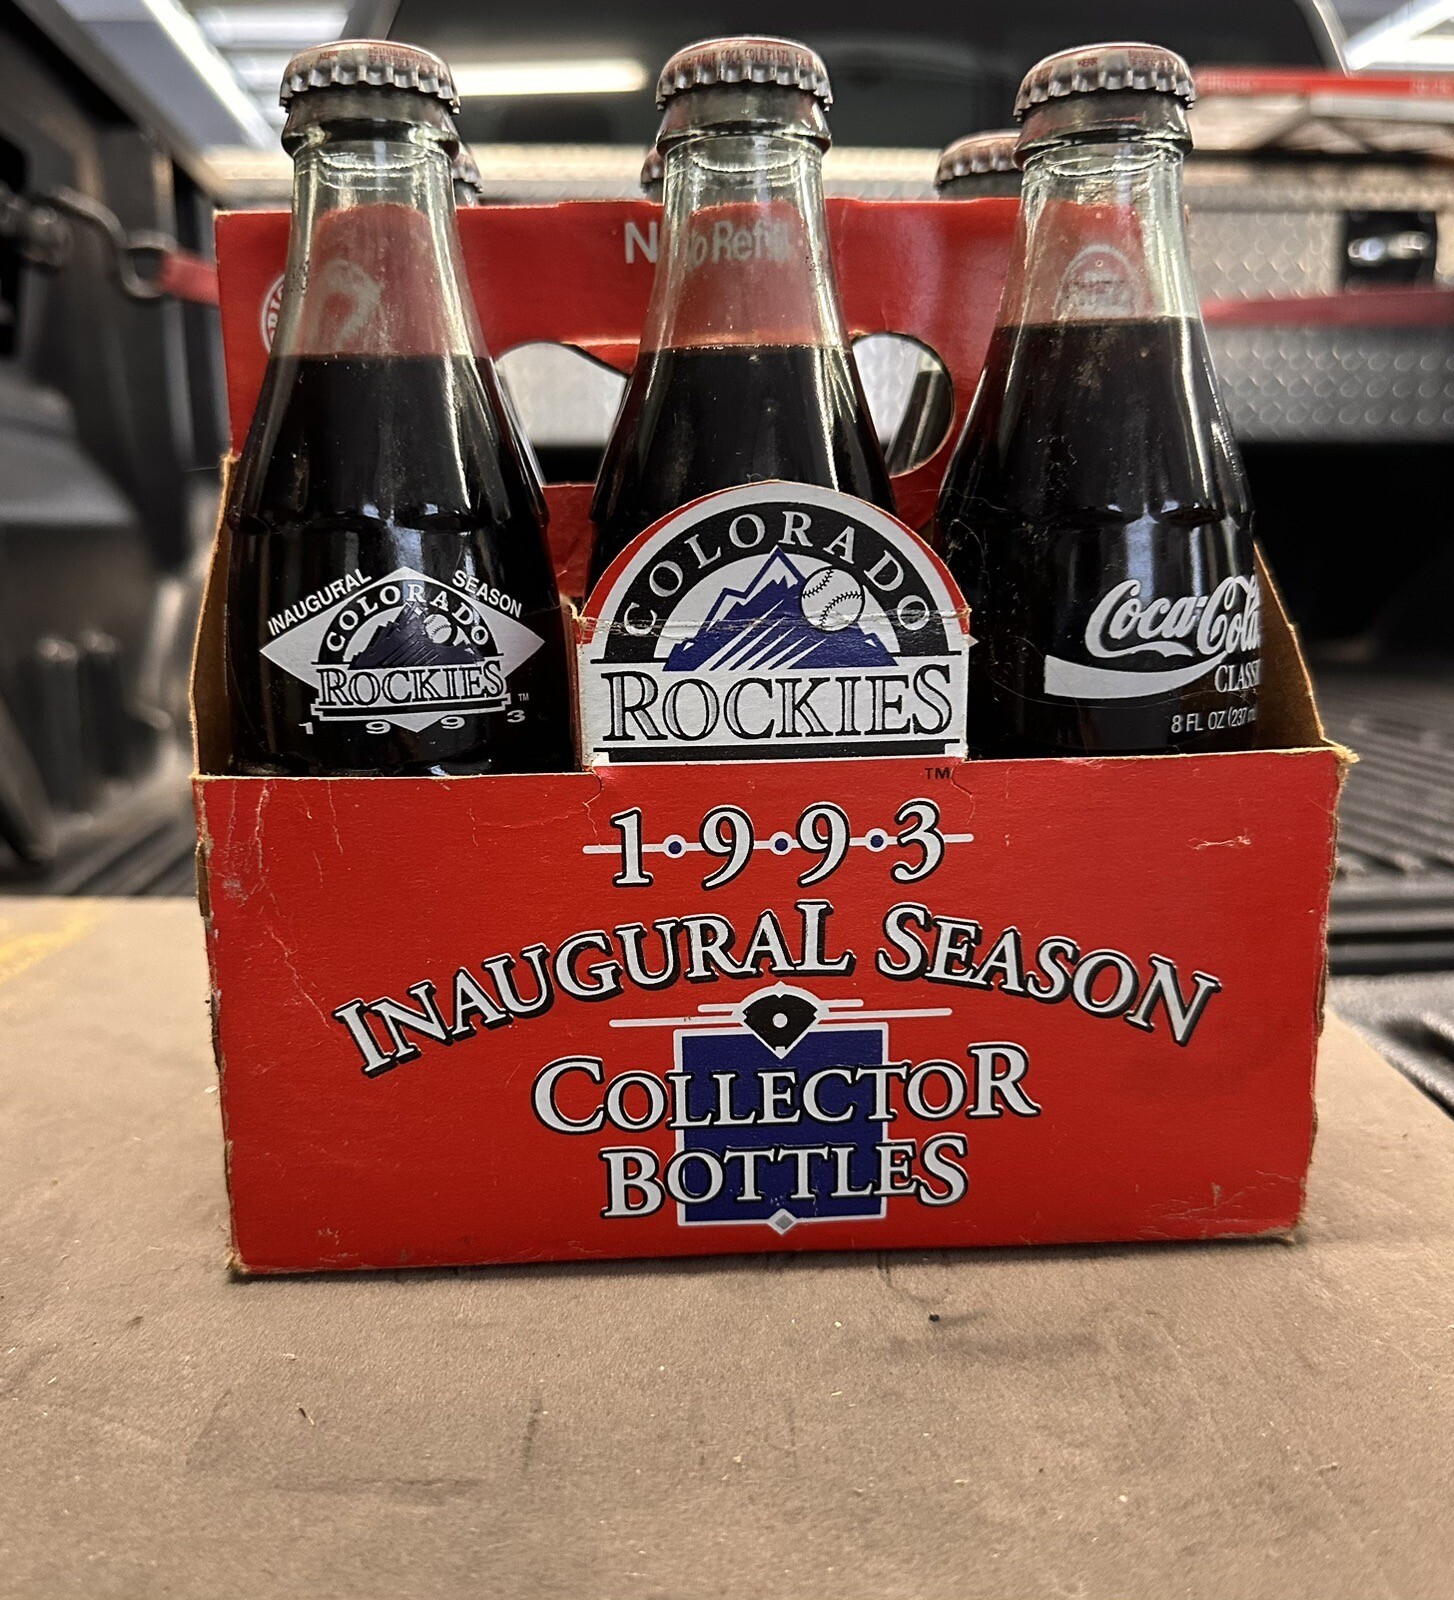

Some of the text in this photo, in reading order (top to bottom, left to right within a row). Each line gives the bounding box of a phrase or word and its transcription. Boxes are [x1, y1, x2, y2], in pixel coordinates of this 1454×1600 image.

[267, 568, 523, 636] INAUGURAL SEASON
[623, 510, 930, 638] COLORADO
[326, 583, 489, 652] COLORADO
[1085, 574, 1260, 659] Coca-Cola
[316, 660, 506, 707] ROCKIES
[518, 693, 529, 702] TM
[600, 663, 952, 742] ROCKIES
[1171, 714, 1183, 733] 8
[1186, 713, 1203, 732] FL
[1208, 710, 1226, 730] OZ
[925, 766, 951, 780] TM
[333, 898, 1222, 1079] INAUGURAL SEASON
[530, 1040, 1042, 1135] COLLECTOR
[599, 1132, 970, 1220] BOTTLES
